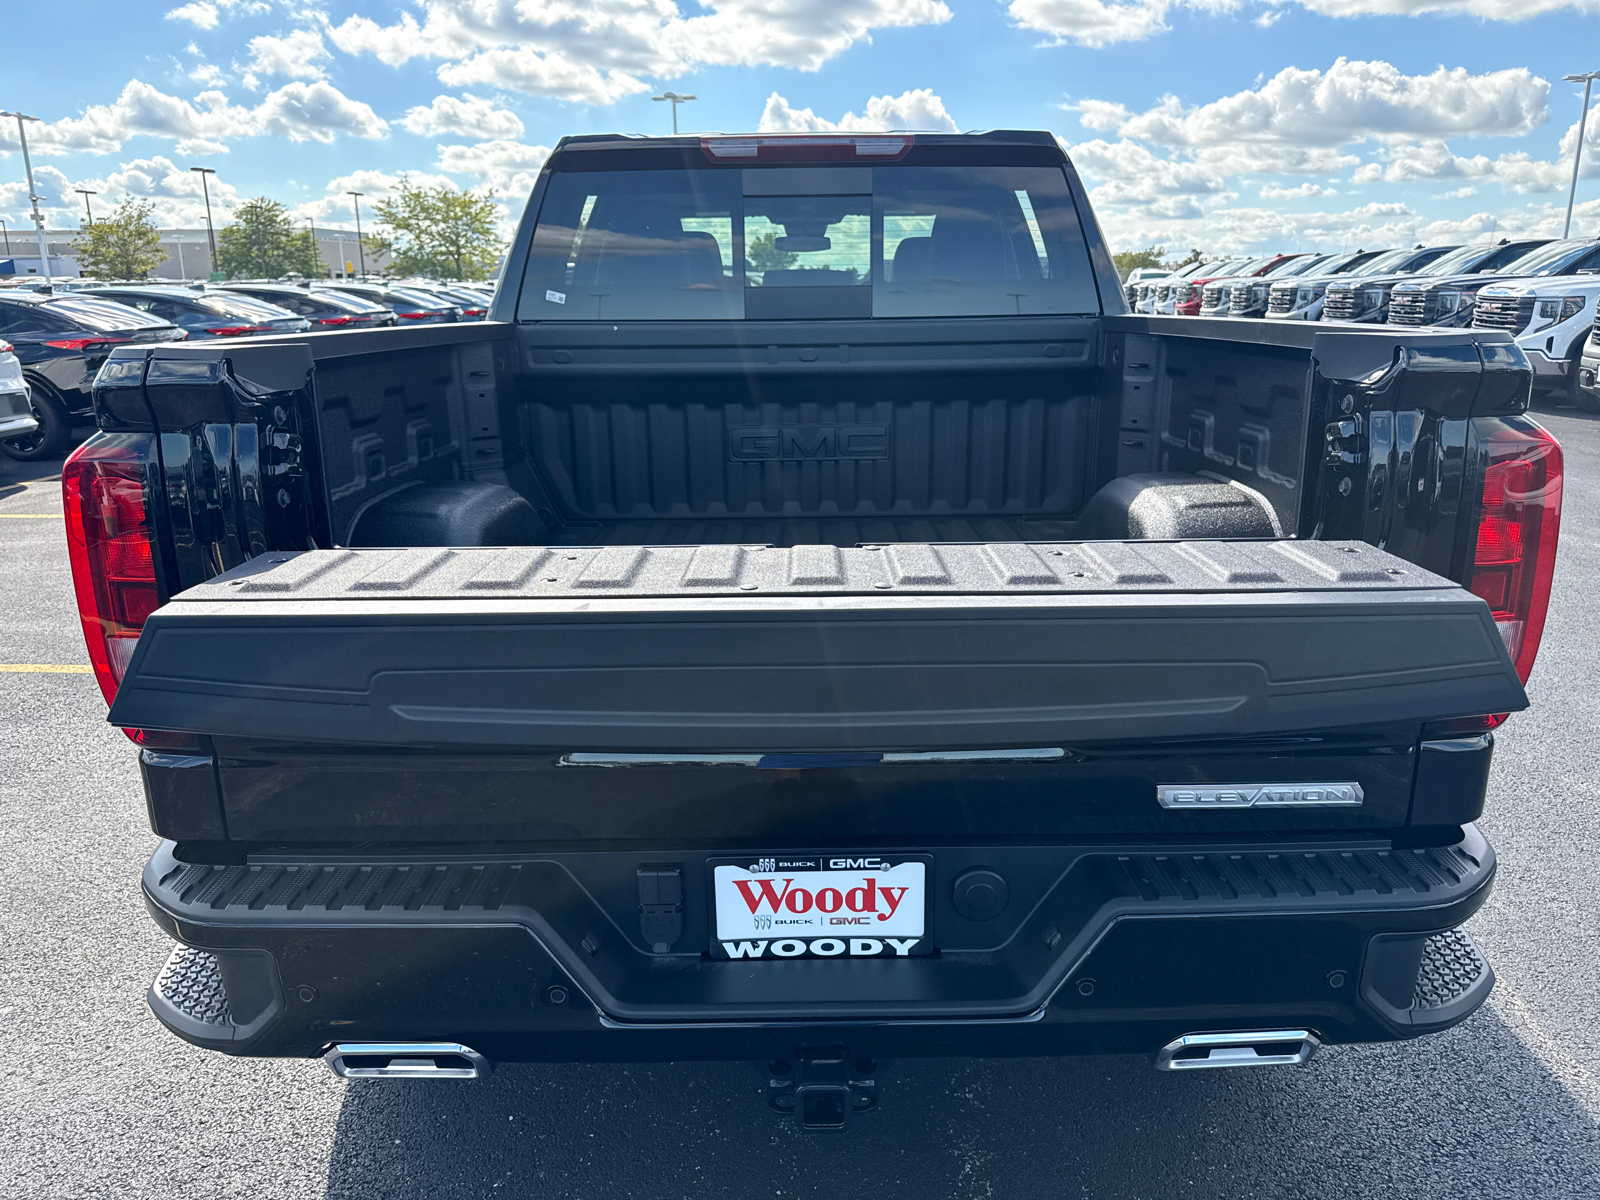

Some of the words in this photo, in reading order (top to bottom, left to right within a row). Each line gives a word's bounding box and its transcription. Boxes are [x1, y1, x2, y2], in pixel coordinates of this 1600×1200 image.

[732, 427, 888, 459] GMC
[1173, 788, 1349, 803] ELEVATION
[829, 858, 881, 869] GMC
[732, 878, 909, 921] Woody
[829, 917, 871, 925] GMC
[722, 938, 920, 959] WOODY
